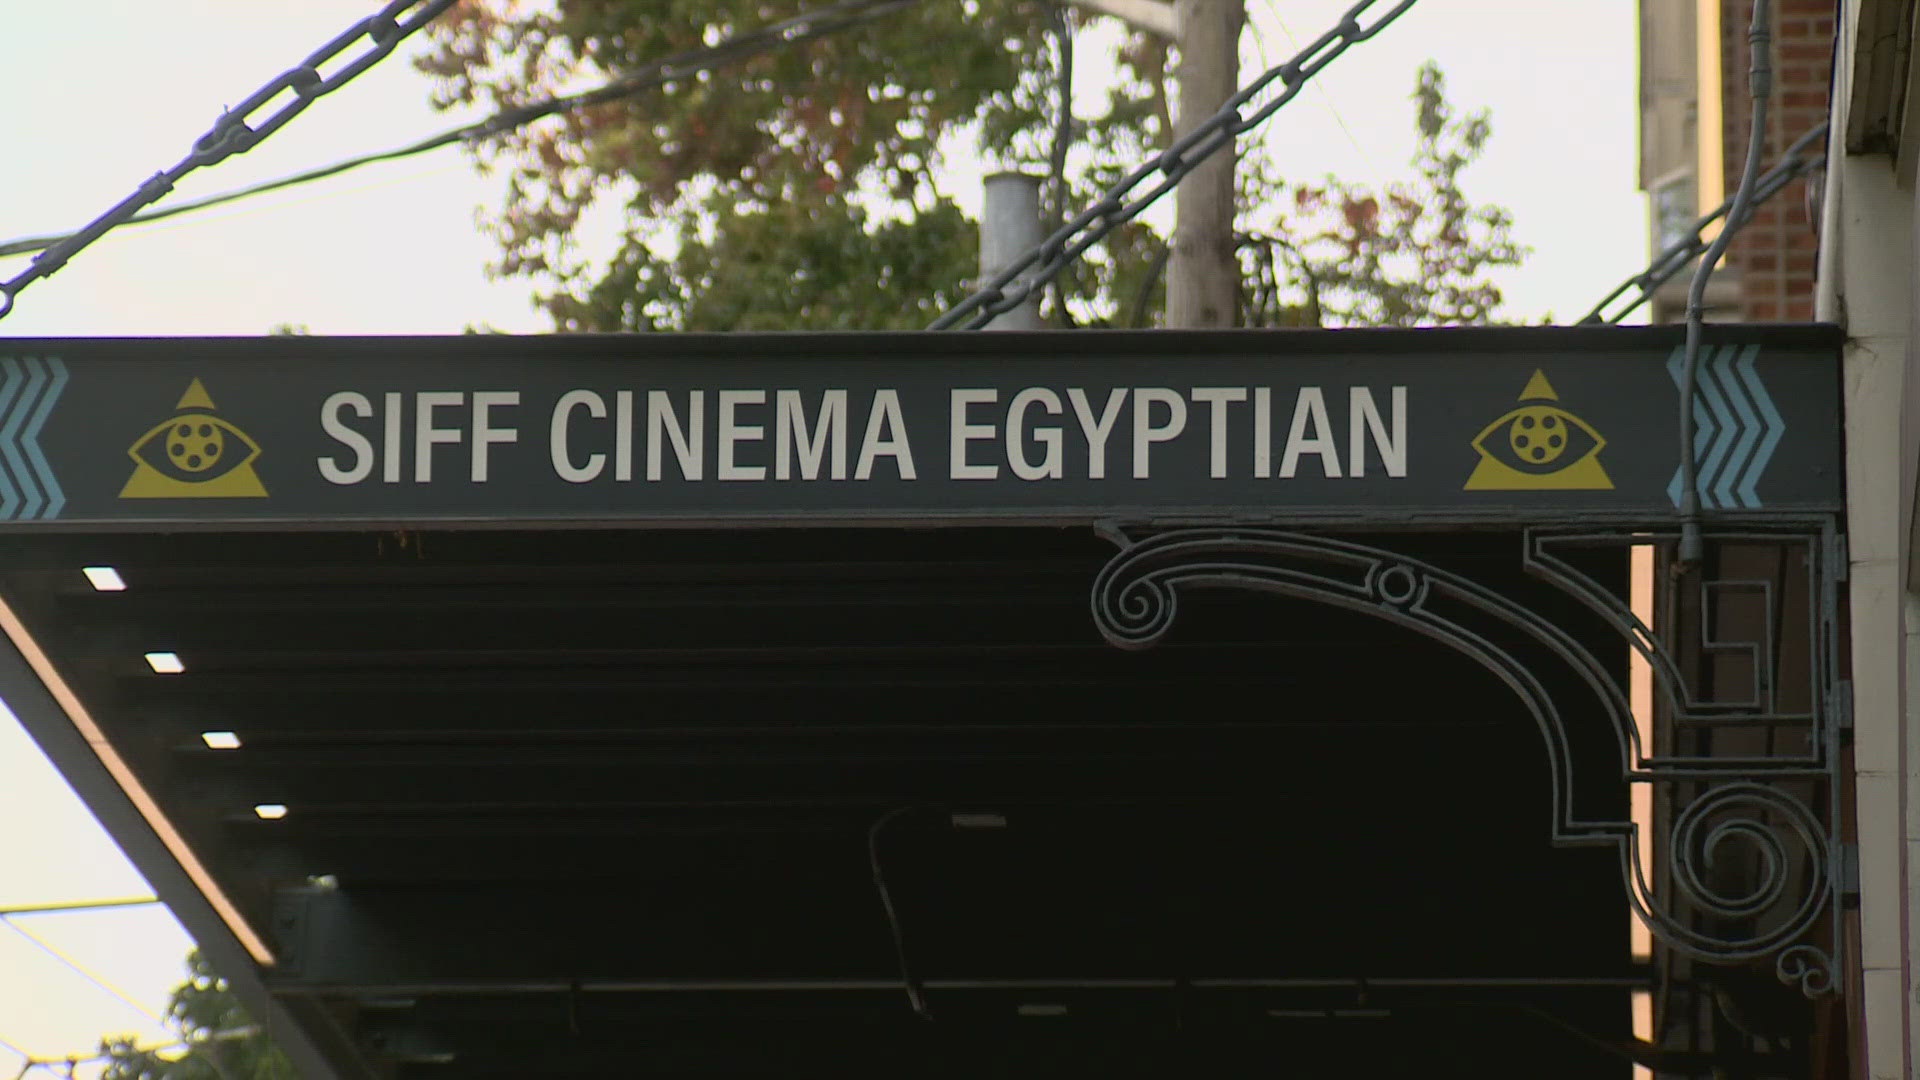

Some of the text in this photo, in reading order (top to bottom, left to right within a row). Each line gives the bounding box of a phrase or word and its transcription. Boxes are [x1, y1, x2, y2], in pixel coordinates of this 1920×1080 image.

[317, 386, 1408, 485] SIFF CINEMA EGYPTIAN
